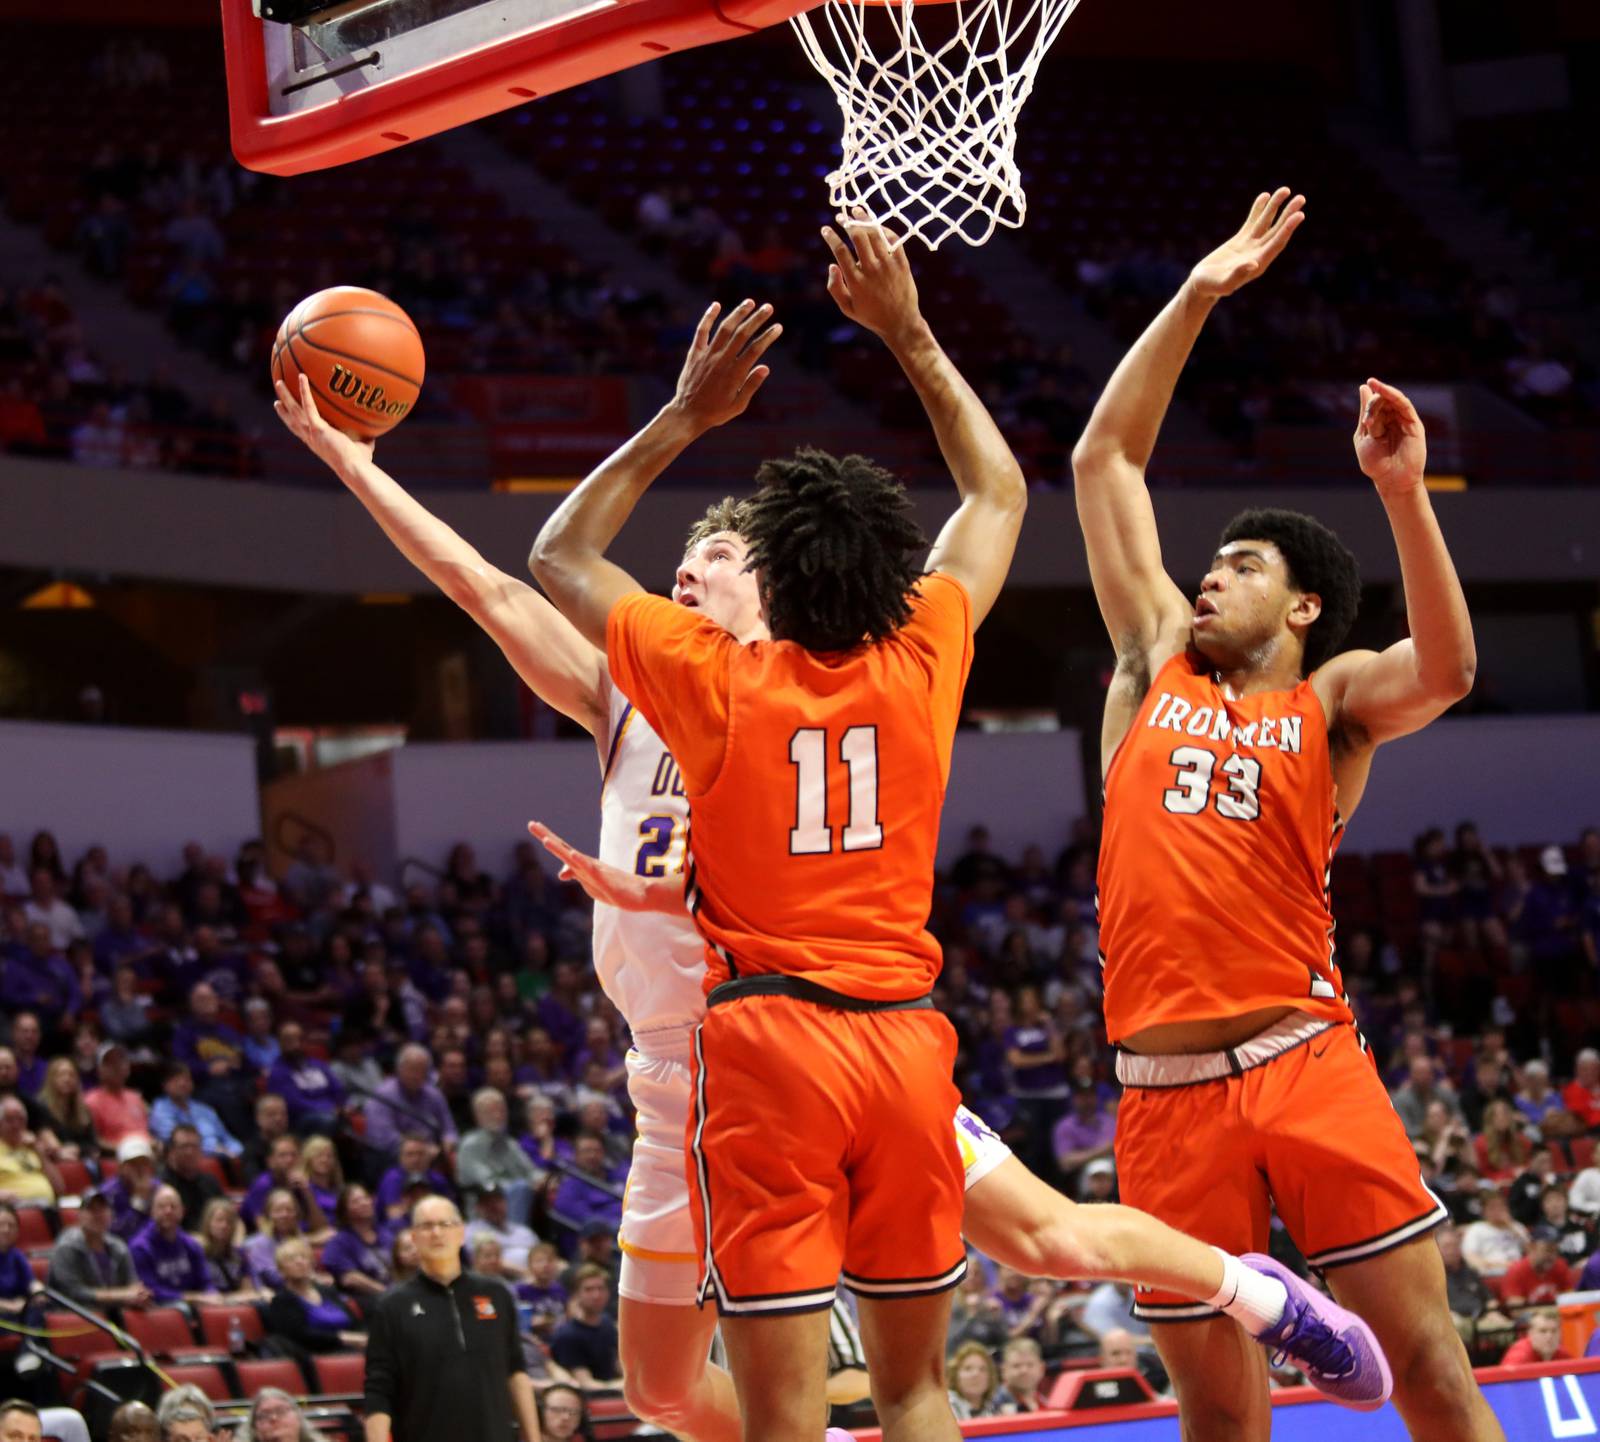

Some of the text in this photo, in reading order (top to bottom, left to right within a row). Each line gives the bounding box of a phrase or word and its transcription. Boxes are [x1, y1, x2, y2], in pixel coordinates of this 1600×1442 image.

[328, 363, 409, 417] Wilson
[1147, 692, 1303, 754] IRONMEN
[788, 725, 884, 856] 11
[1162, 745, 1263, 821] 33
[635, 812, 687, 878] 2
